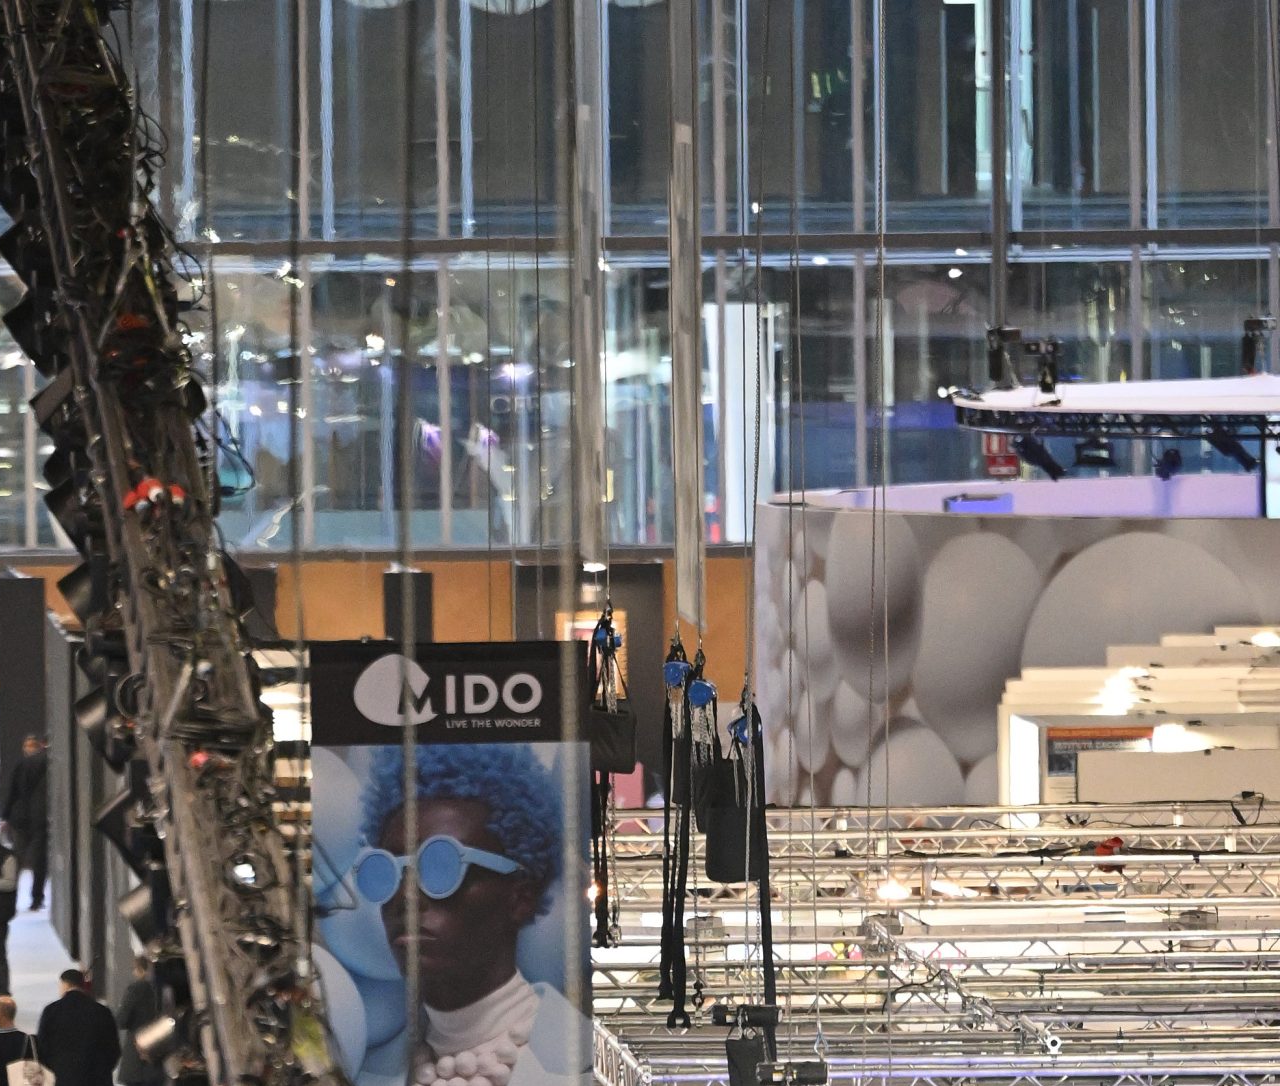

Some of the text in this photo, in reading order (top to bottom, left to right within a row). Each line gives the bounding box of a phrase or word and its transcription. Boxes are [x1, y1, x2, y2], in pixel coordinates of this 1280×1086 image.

[446, 718, 541, 729] LIVE THE WONDER
